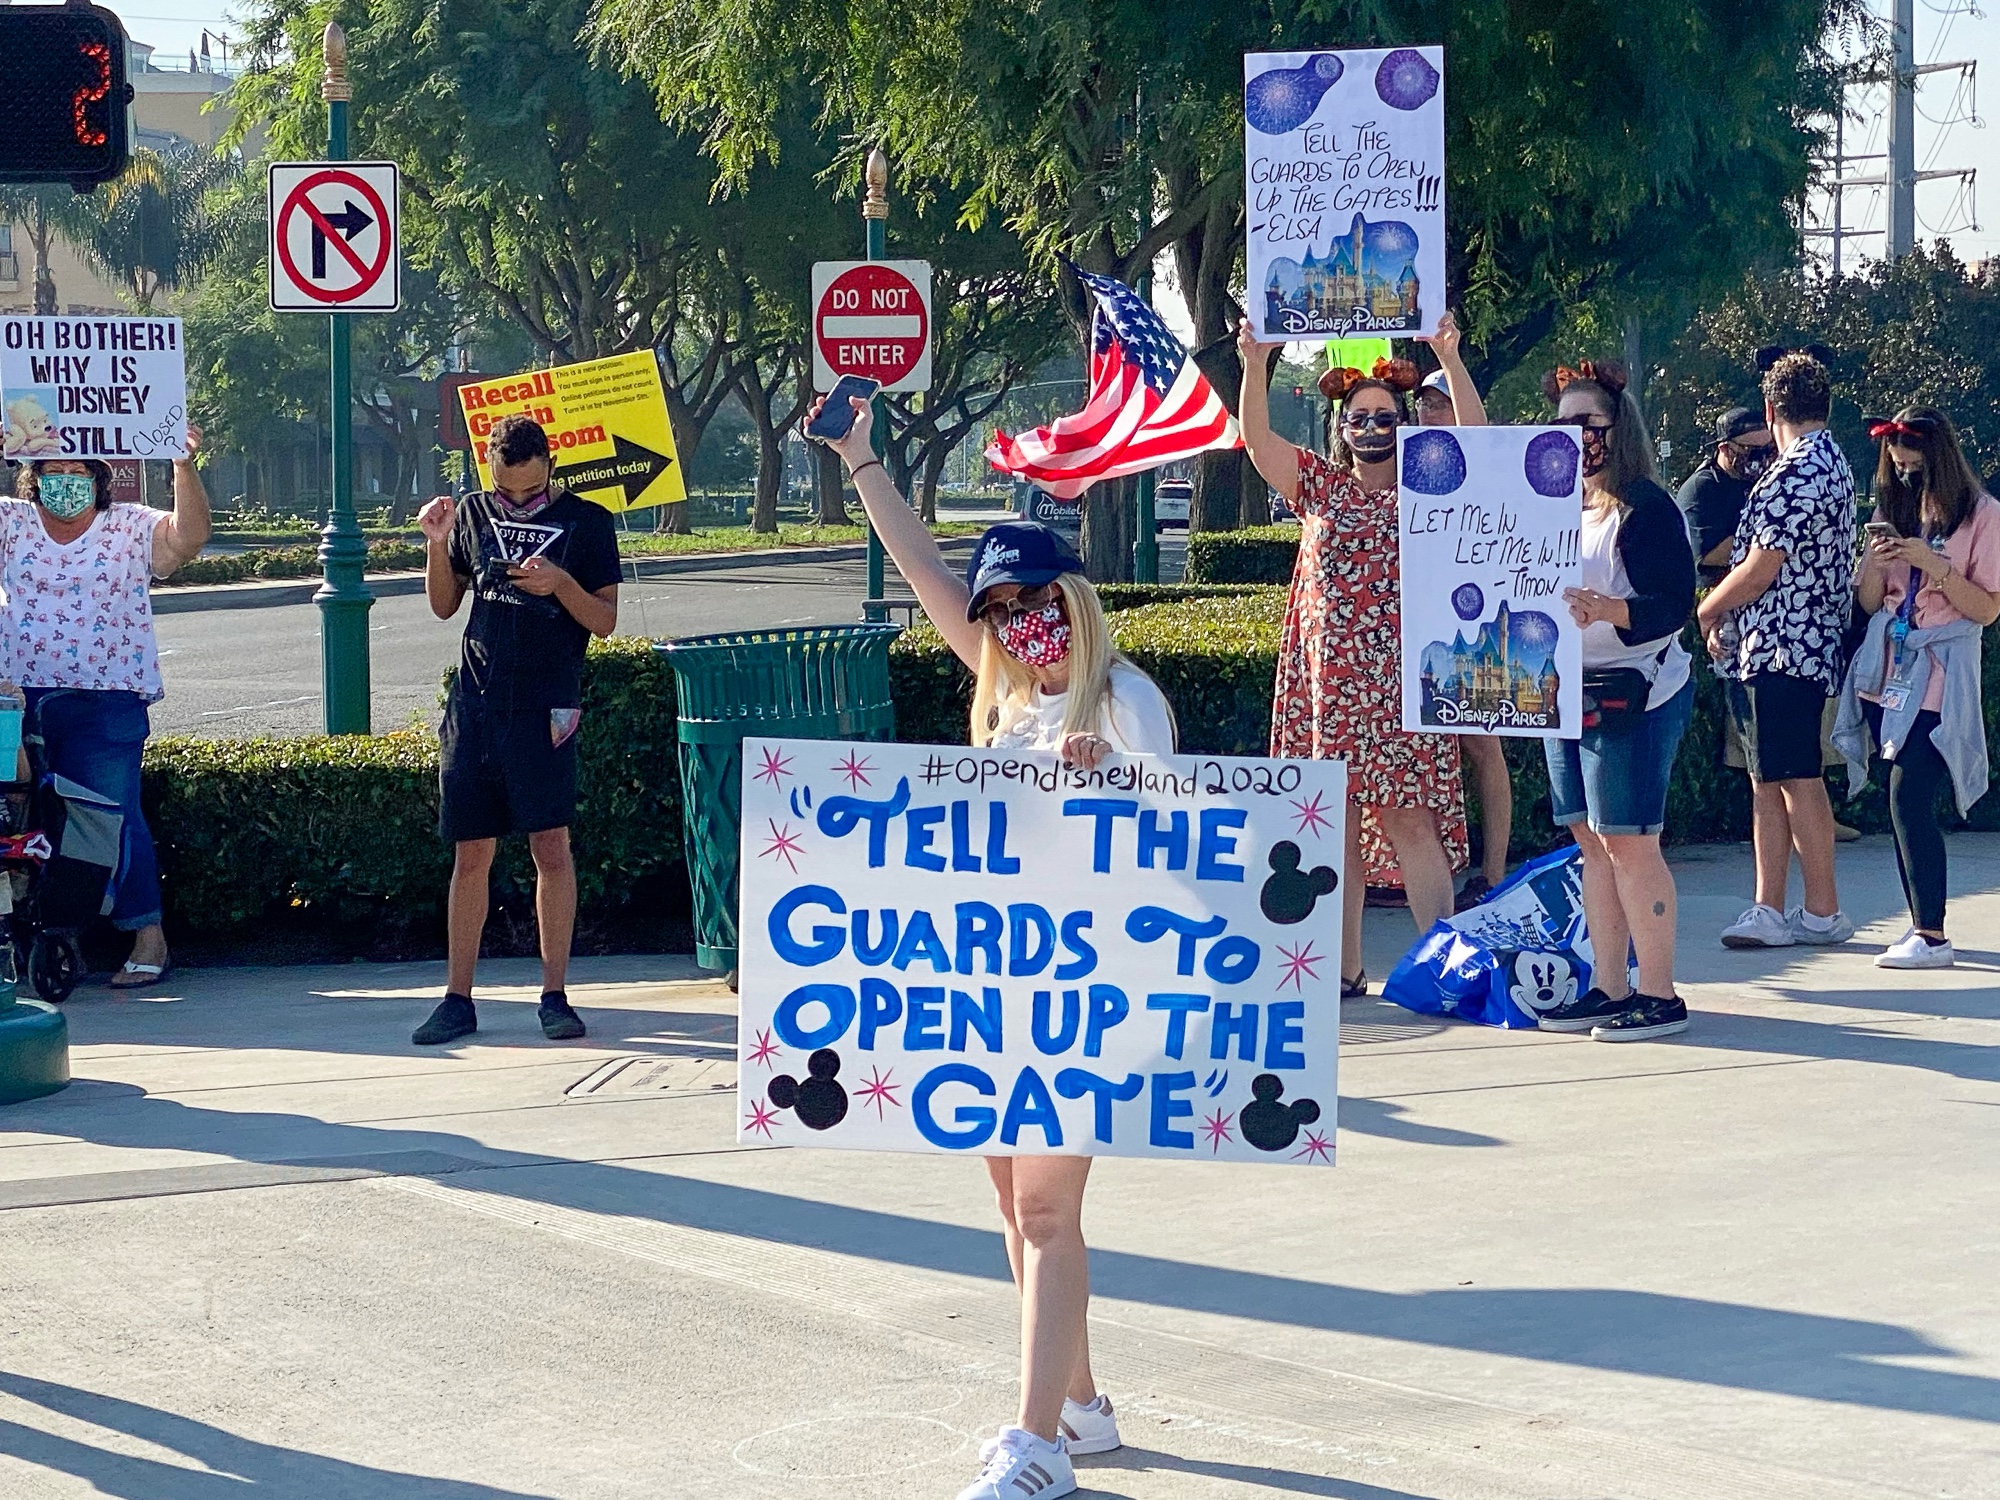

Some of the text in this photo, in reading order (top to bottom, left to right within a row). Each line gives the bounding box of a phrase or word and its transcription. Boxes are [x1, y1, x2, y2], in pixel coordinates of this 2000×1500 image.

[73, 44, 110, 146] 2
[1298, 121, 1391, 154] TELL THE
[1251, 152, 1426, 184] GUARDS TO OPEN
[1290, 184, 1327, 214] THE
[833, 288, 909, 310] DO NOT
[5, 321, 176, 351] OH BOTHER!
[838, 344, 905, 365] ENTER
[31, 356, 137, 384] WHY IS
[612, 371, 634, 381] person
[58, 385, 150, 414] DISNEY
[461, 372, 556, 411] Recall
[584, 388, 610, 400] petitions
[469, 404, 556, 436] Gin
[60, 426, 132, 454] STILL
[567, 468, 615, 488] petition
[616, 460, 651, 478] today
[1409, 503, 1517, 535] LET ME IN
[1455, 537, 1498, 564] LET
[1499, 536, 1532, 565] ME
[1063, 798, 1248, 882] THE
[768, 884, 1260, 984] GUARDS TO
[773, 978, 1306, 1070] OPEN UP THE
